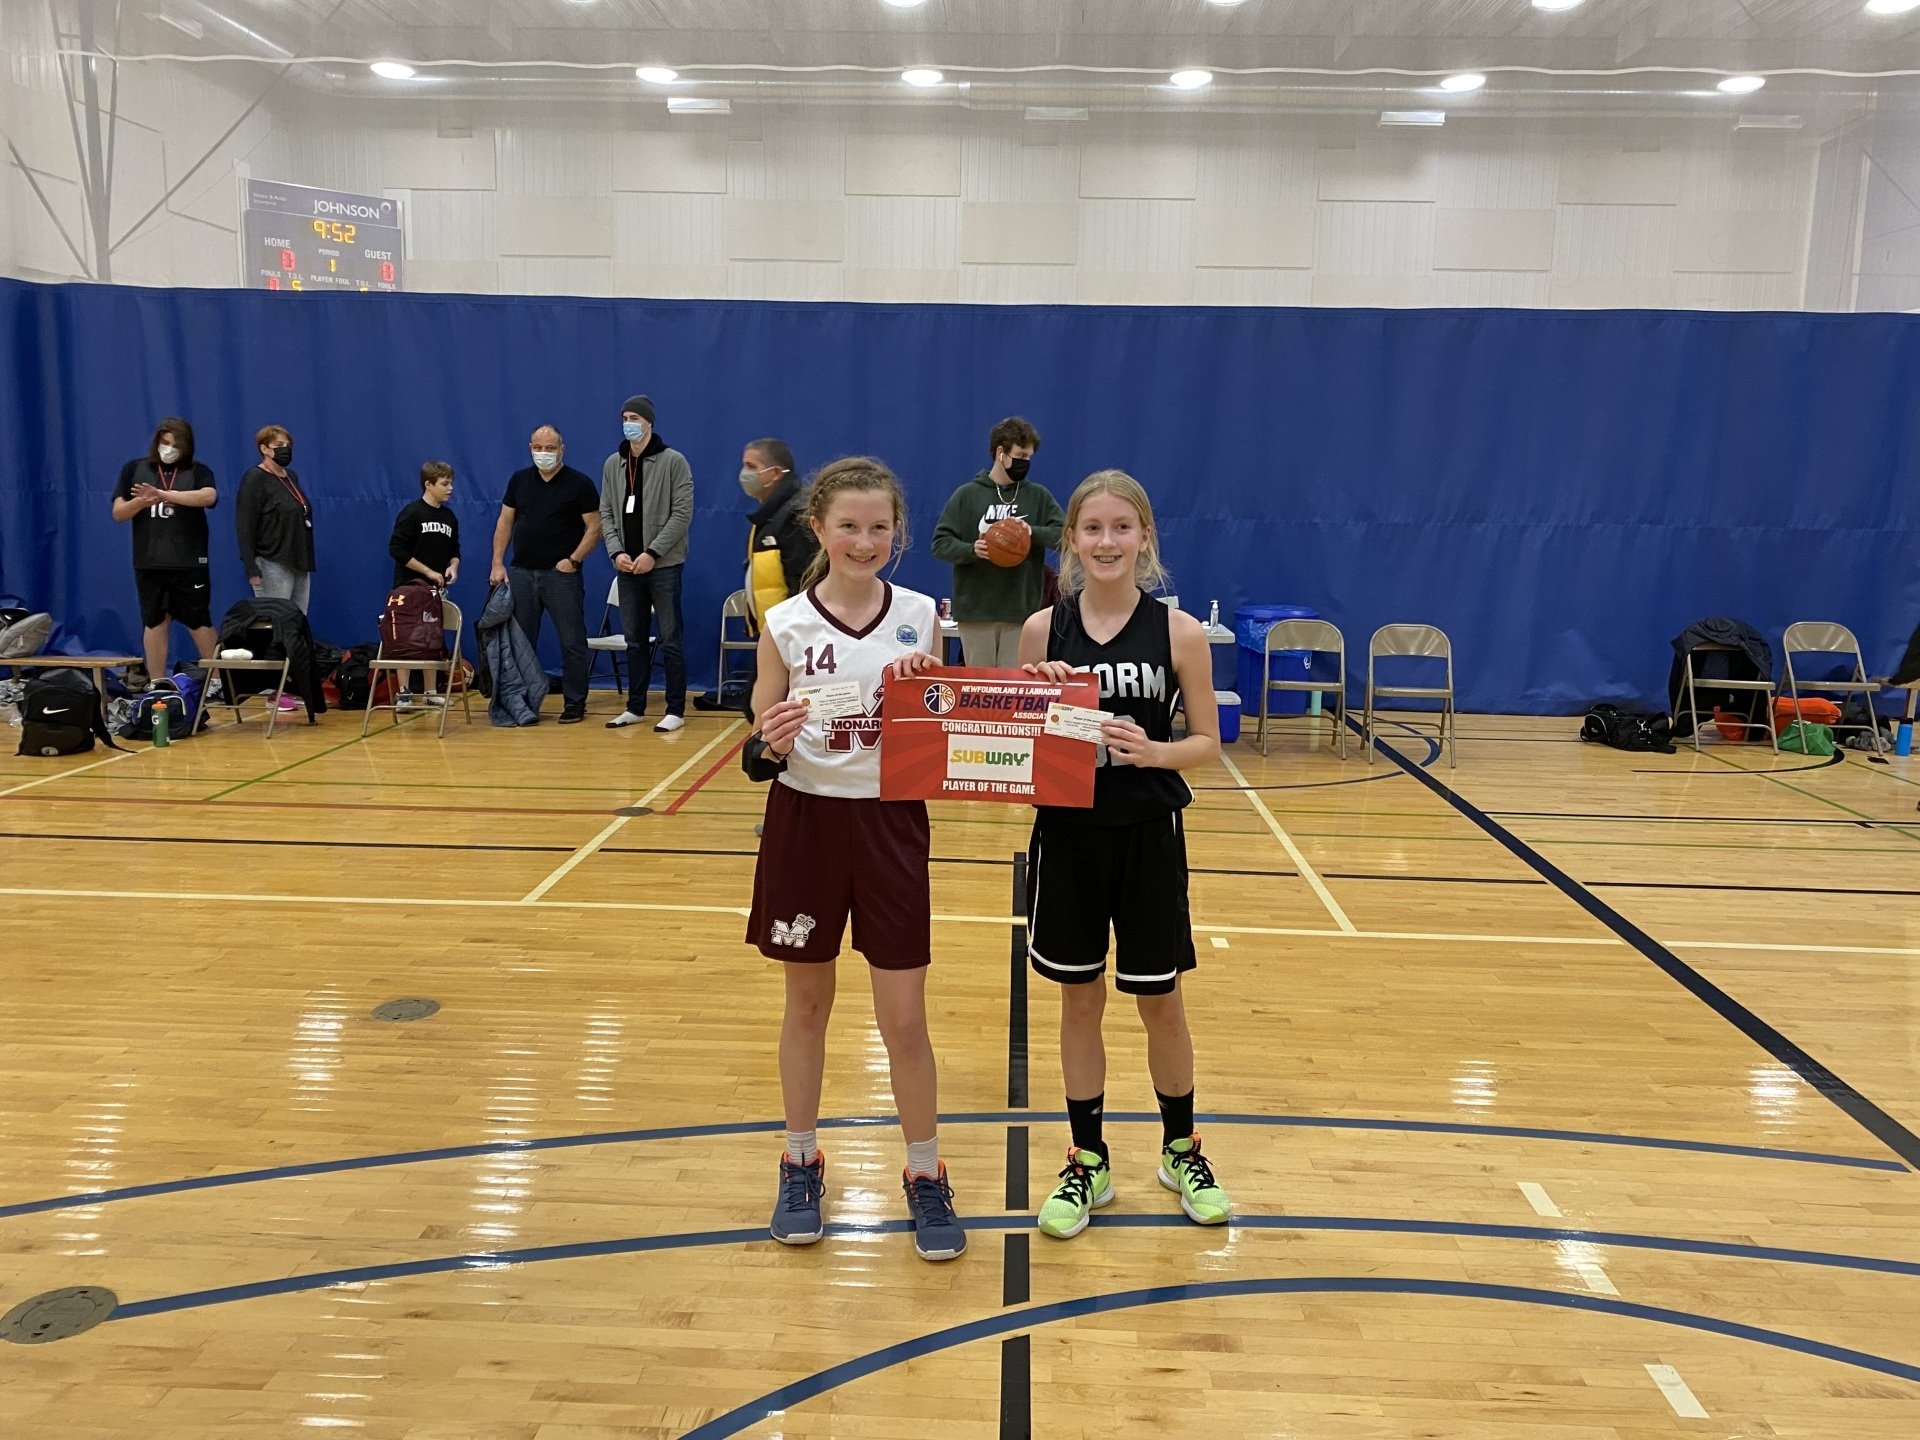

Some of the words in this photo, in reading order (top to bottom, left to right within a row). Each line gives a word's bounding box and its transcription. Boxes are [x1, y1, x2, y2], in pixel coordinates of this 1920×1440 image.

[313, 200, 380, 220] JOHNSON
[313, 221, 356, 243] 9:52
[264, 237, 291, 248] HOME
[318, 248, 340, 257] PERIOD
[364, 249, 392, 260] GUEST
[310, 274, 333, 284] PLAYER
[421, 522, 452, 538] MDJH
[804, 643, 837, 676] 14
[1073, 662, 1167, 703] ORM
[961, 685, 1018, 695] NEWFOUNDLAND
[1025, 687, 1062, 696] LABRADOR
[1012, 711, 1048, 720] ASSOCIAT
[831, 720, 882, 730] MONAR
[942, 722, 1041, 737] CONGRATULATIONS!!!
[950, 749, 1031, 767] SUBWAY
[942, 780, 977, 792] PLAYER
[977, 781, 989, 792] OF
[991, 783, 1008, 793] THE
[1009, 784, 1036, 795] GAME
